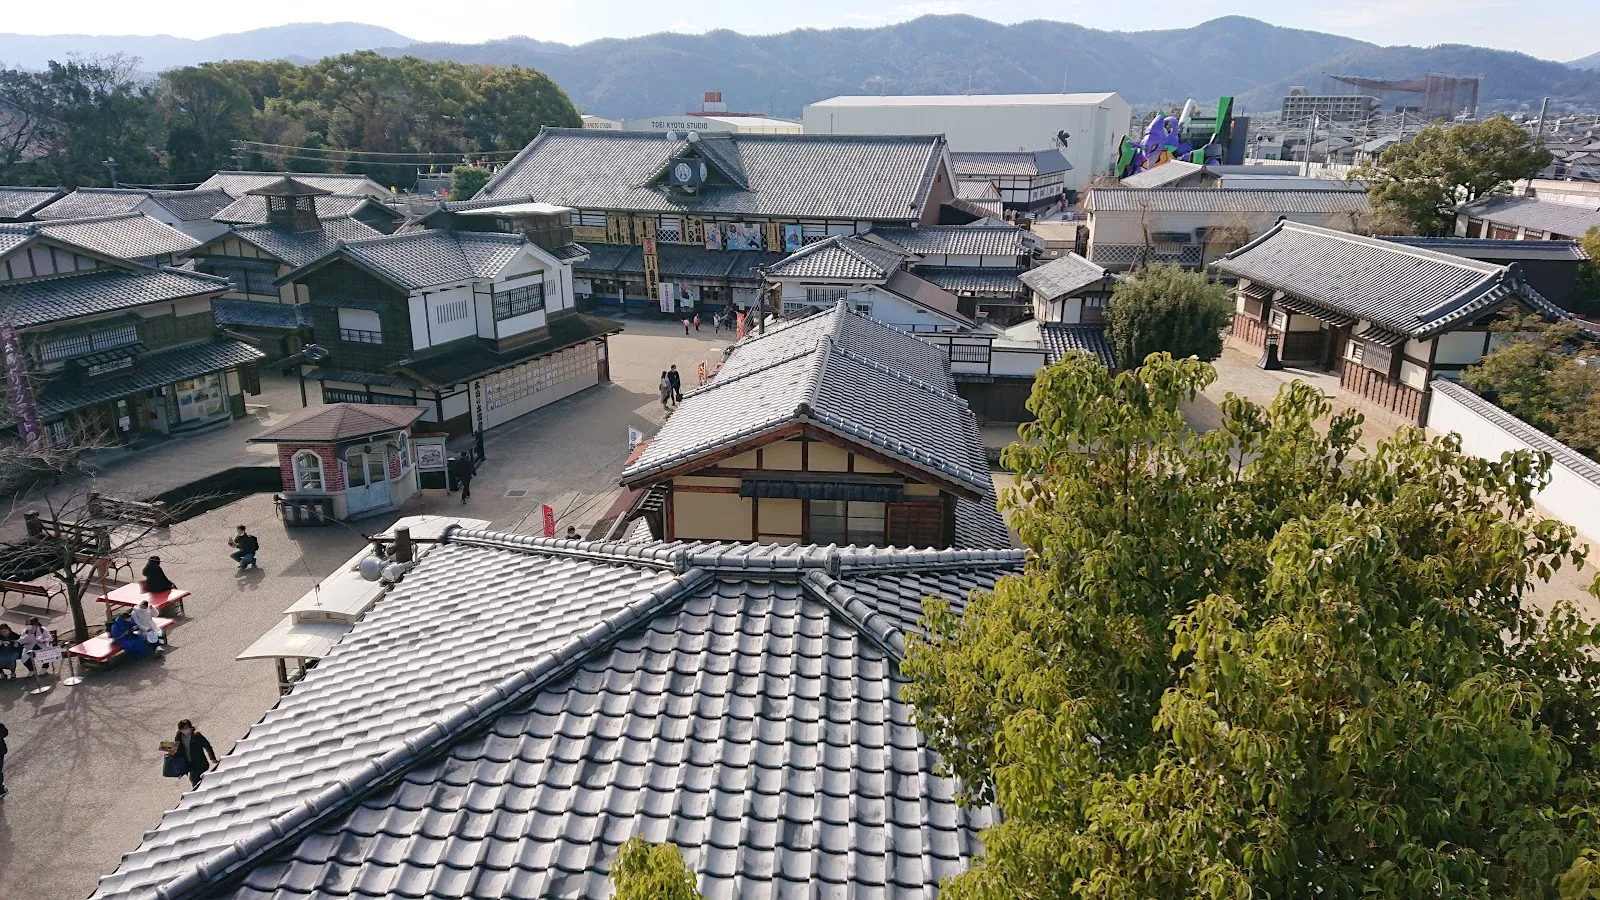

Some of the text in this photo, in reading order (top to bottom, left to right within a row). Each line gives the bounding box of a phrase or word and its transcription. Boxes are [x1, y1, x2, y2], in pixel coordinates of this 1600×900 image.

[651, 121, 708, 130] TOEI KYOTO STUDIO
